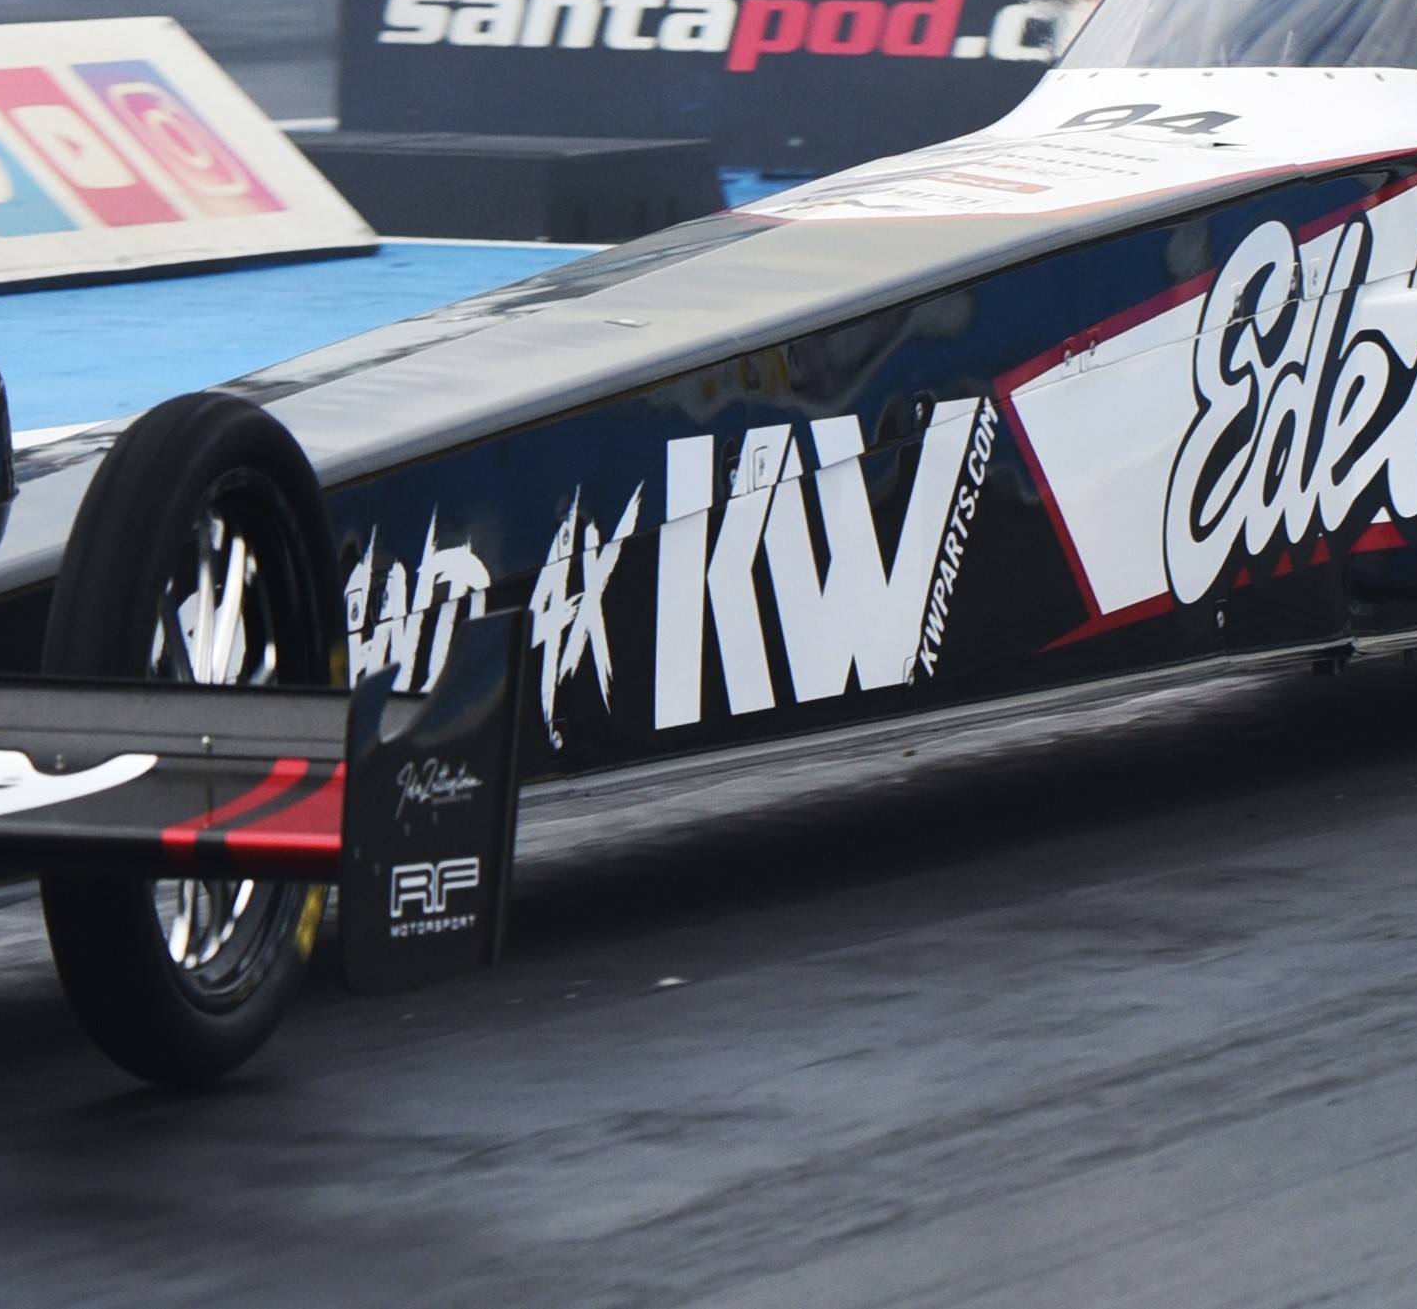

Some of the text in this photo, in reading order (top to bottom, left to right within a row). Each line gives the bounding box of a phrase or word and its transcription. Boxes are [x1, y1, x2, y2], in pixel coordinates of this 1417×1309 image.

[1036, 103, 1243, 138] 94
[1039, 143, 1160, 163] eZone
[919, 397, 999, 676] KWPARTS.COM
[655, 397, 982, 729] KW
[390, 857, 480, 918] RF
[391, 914, 476, 937] MOTORSPORT
